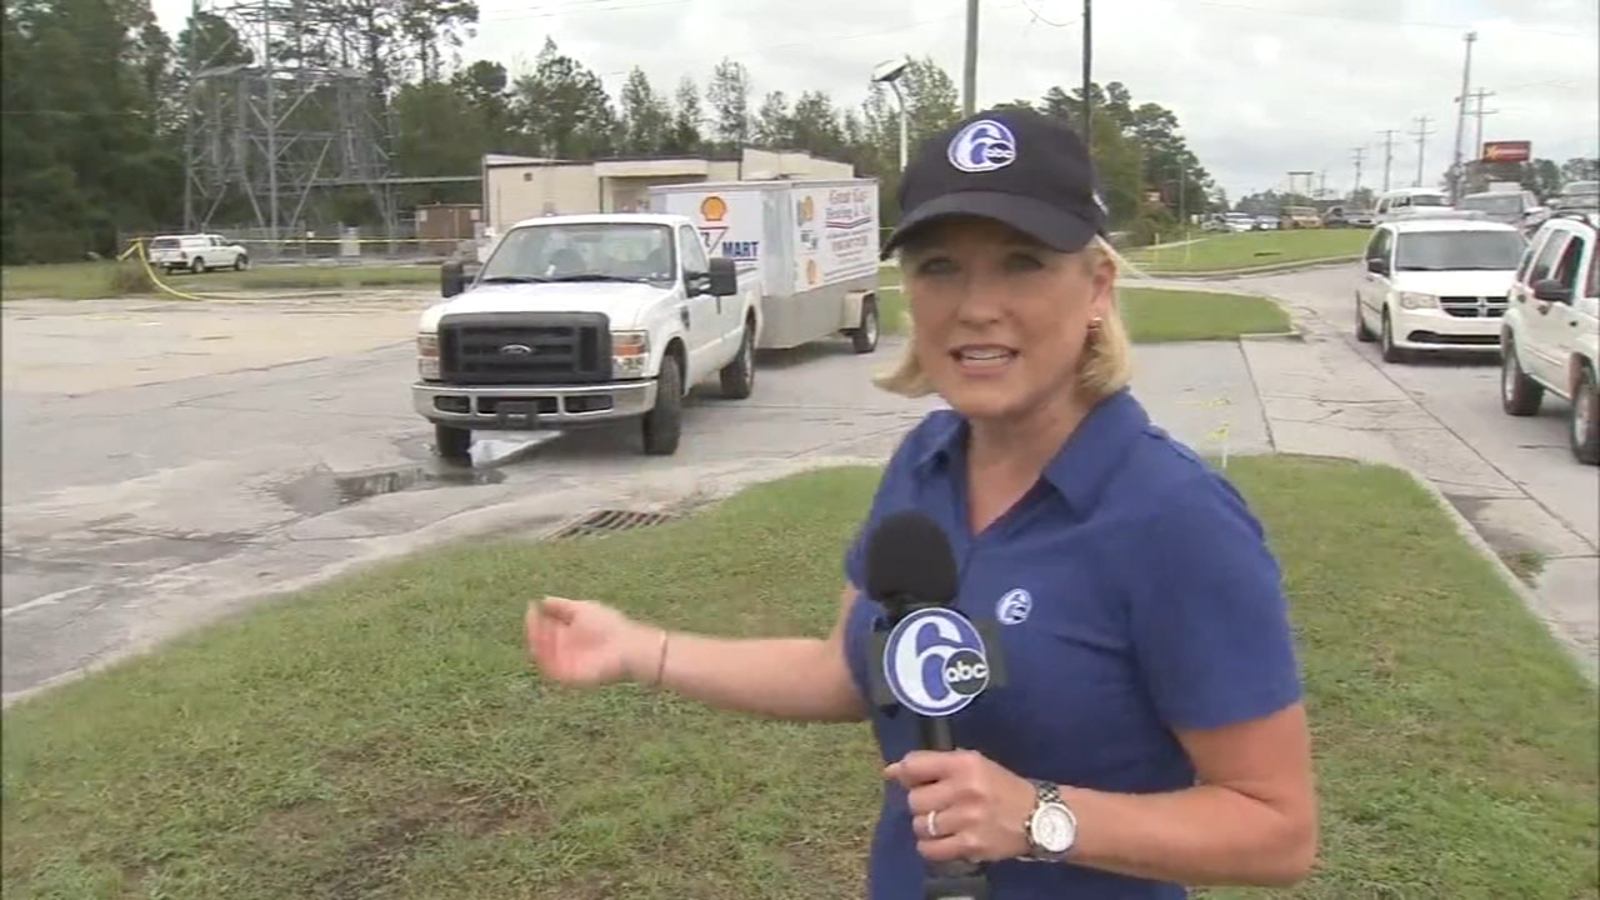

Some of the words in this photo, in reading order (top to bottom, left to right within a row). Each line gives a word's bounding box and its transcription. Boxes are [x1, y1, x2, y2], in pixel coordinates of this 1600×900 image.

[722, 241, 759, 257] MART
[895, 615, 975, 709] 6
[945, 661, 988, 682] abc
